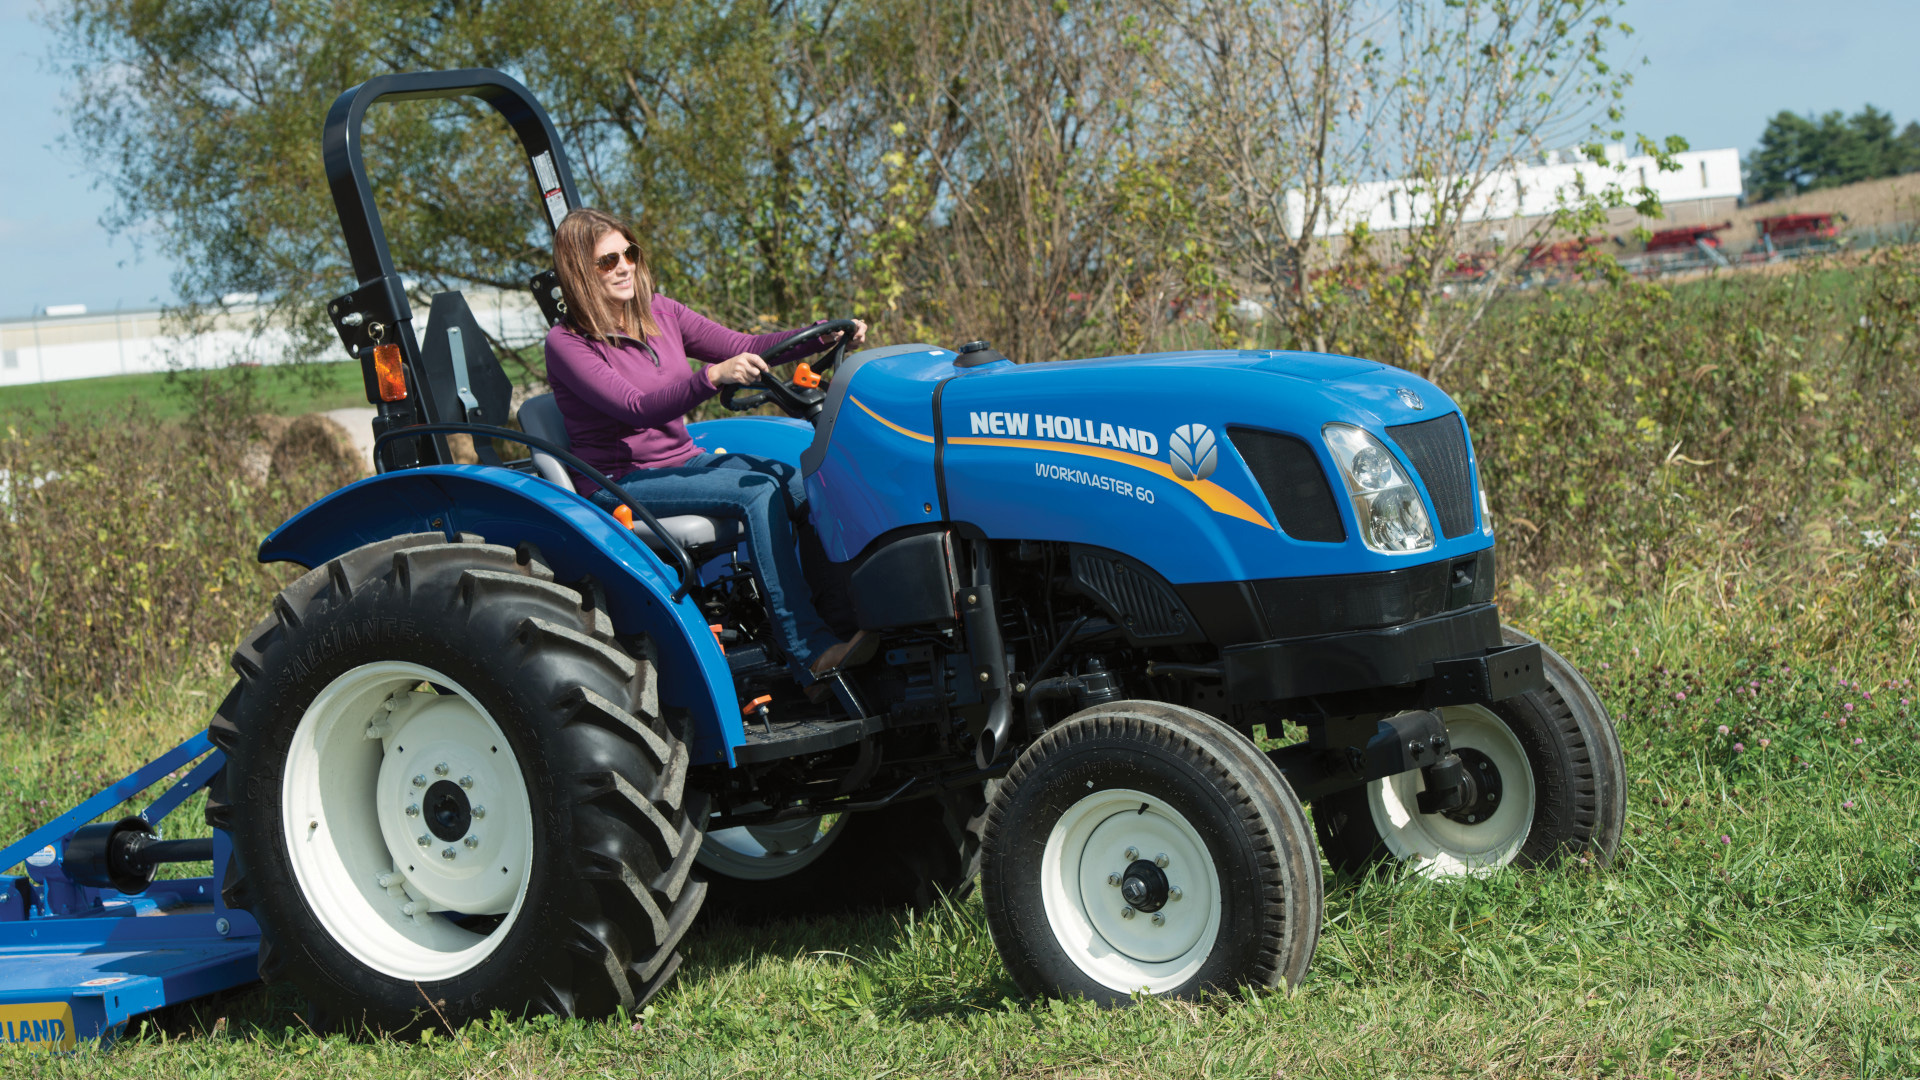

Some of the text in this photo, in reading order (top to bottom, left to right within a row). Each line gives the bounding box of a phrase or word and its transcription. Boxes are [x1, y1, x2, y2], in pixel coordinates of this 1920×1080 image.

[969, 411, 1159, 456] NEW HOLLAND
[1035, 462, 1155, 505] WORKMASTER 60
[292, 617, 416, 684] ALLIANCE
[0, 1019, 66, 1043] LAND
